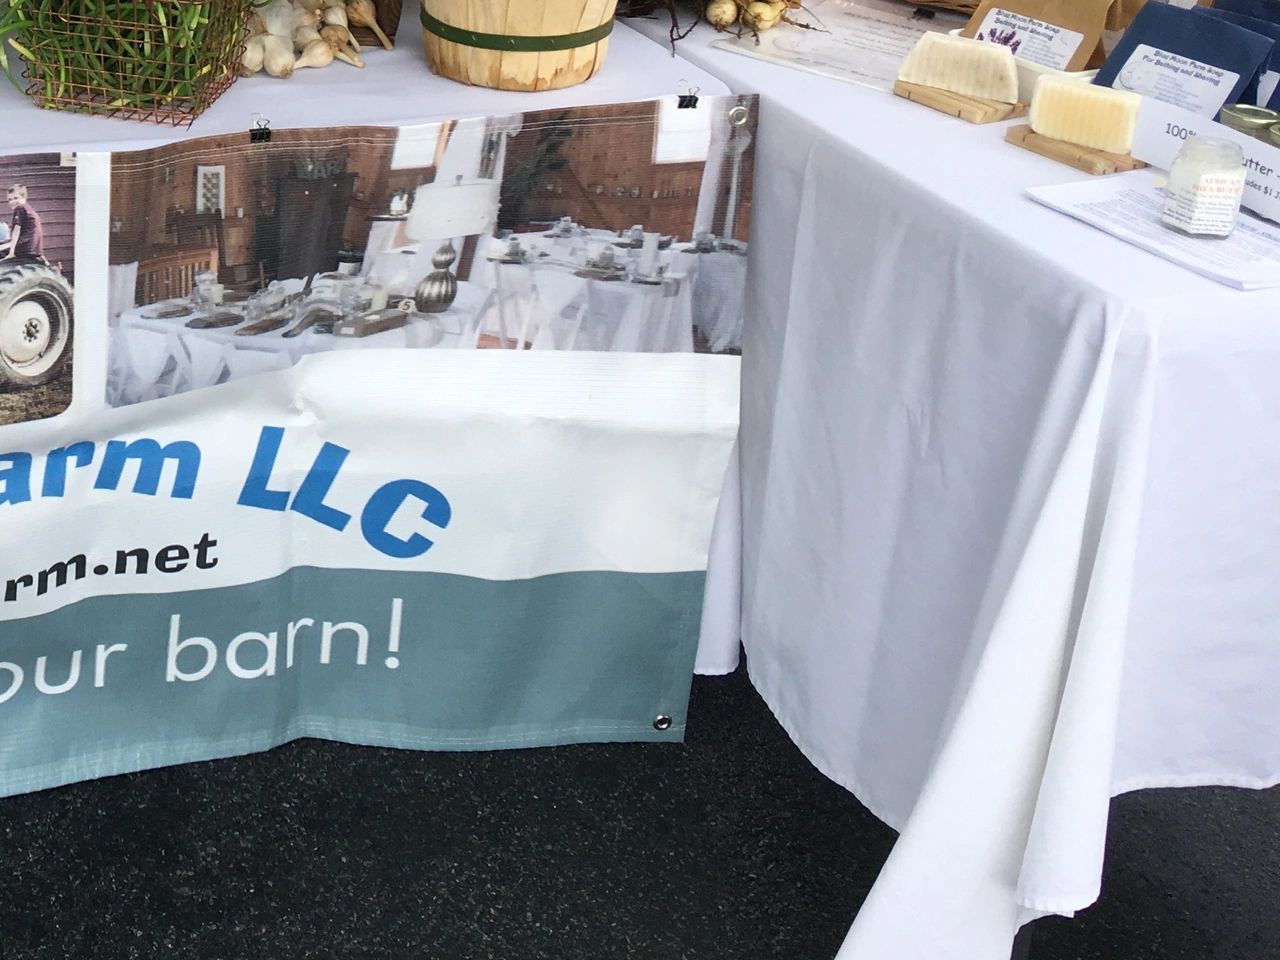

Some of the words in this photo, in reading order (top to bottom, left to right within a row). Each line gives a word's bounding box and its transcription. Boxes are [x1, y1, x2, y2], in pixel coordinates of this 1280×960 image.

[1242, 156, 1274, 177] utter
[236, 425, 453, 559] LLC
[165, 597, 404, 684] barn!
